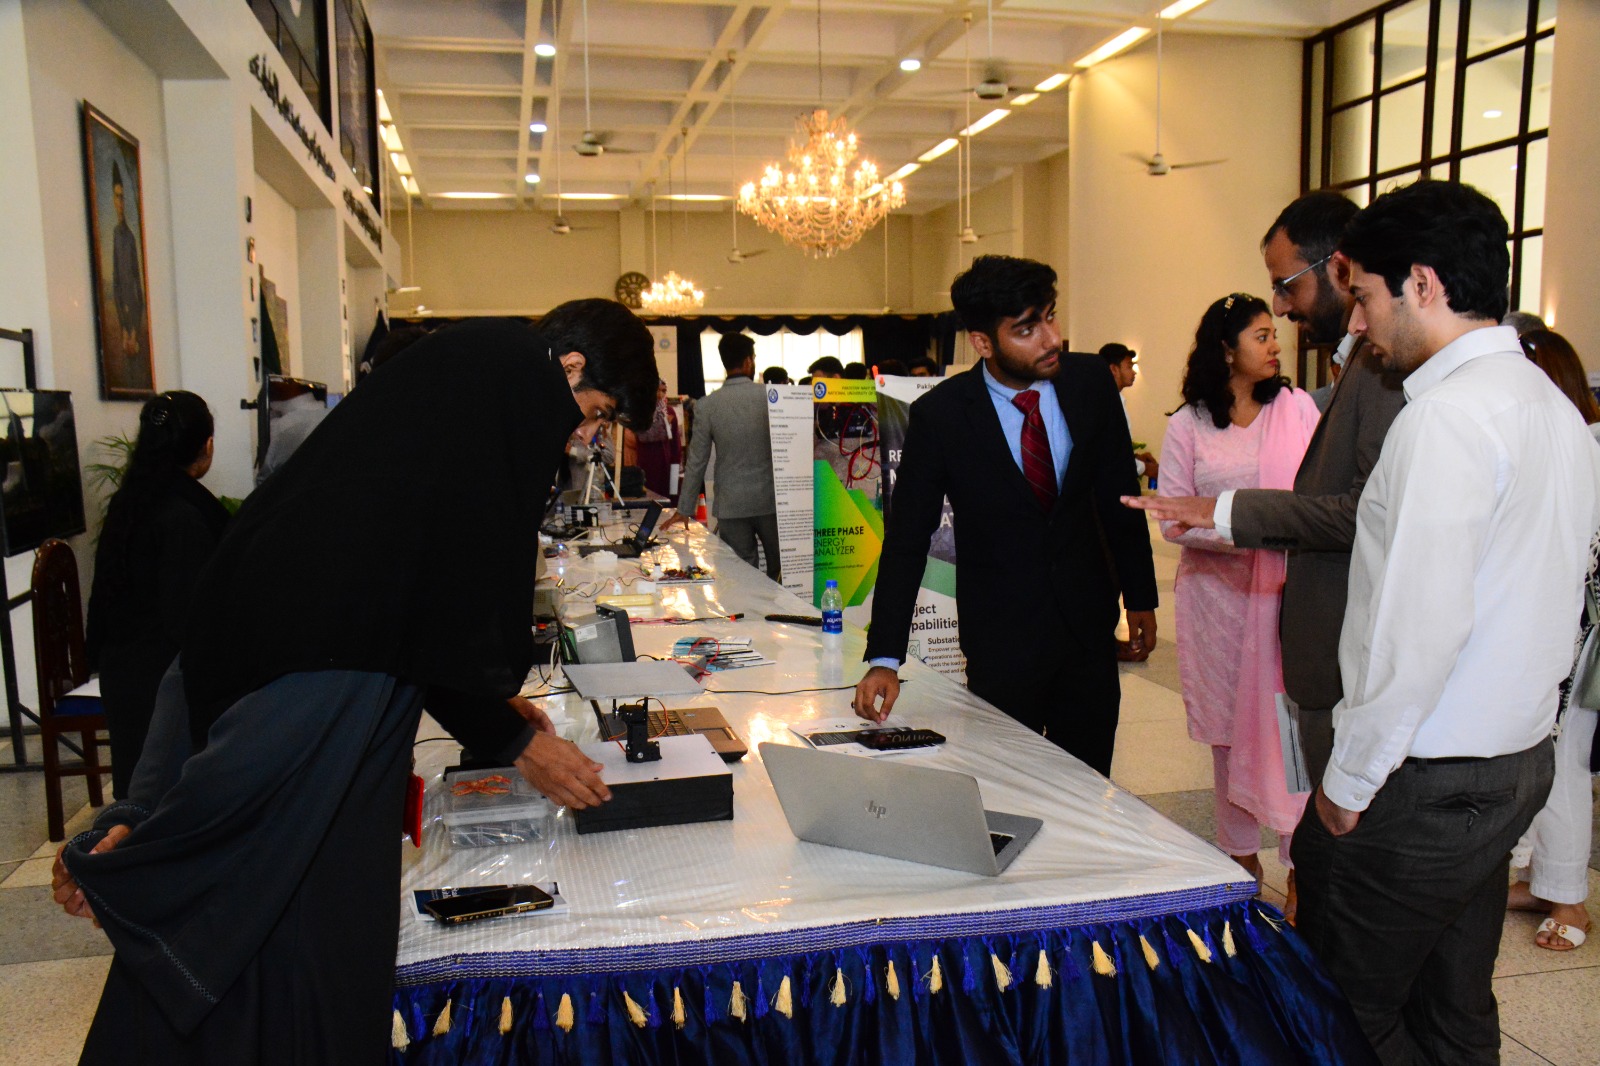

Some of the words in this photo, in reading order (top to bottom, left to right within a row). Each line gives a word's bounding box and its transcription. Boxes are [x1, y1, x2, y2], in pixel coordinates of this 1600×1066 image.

[813, 527, 836, 537] THREE
[837, 526, 864, 536] PHASE
[814, 537, 845, 547] ENERGY
[814, 545, 855, 556] ANALYZER
[868, 800, 887, 818] hp
